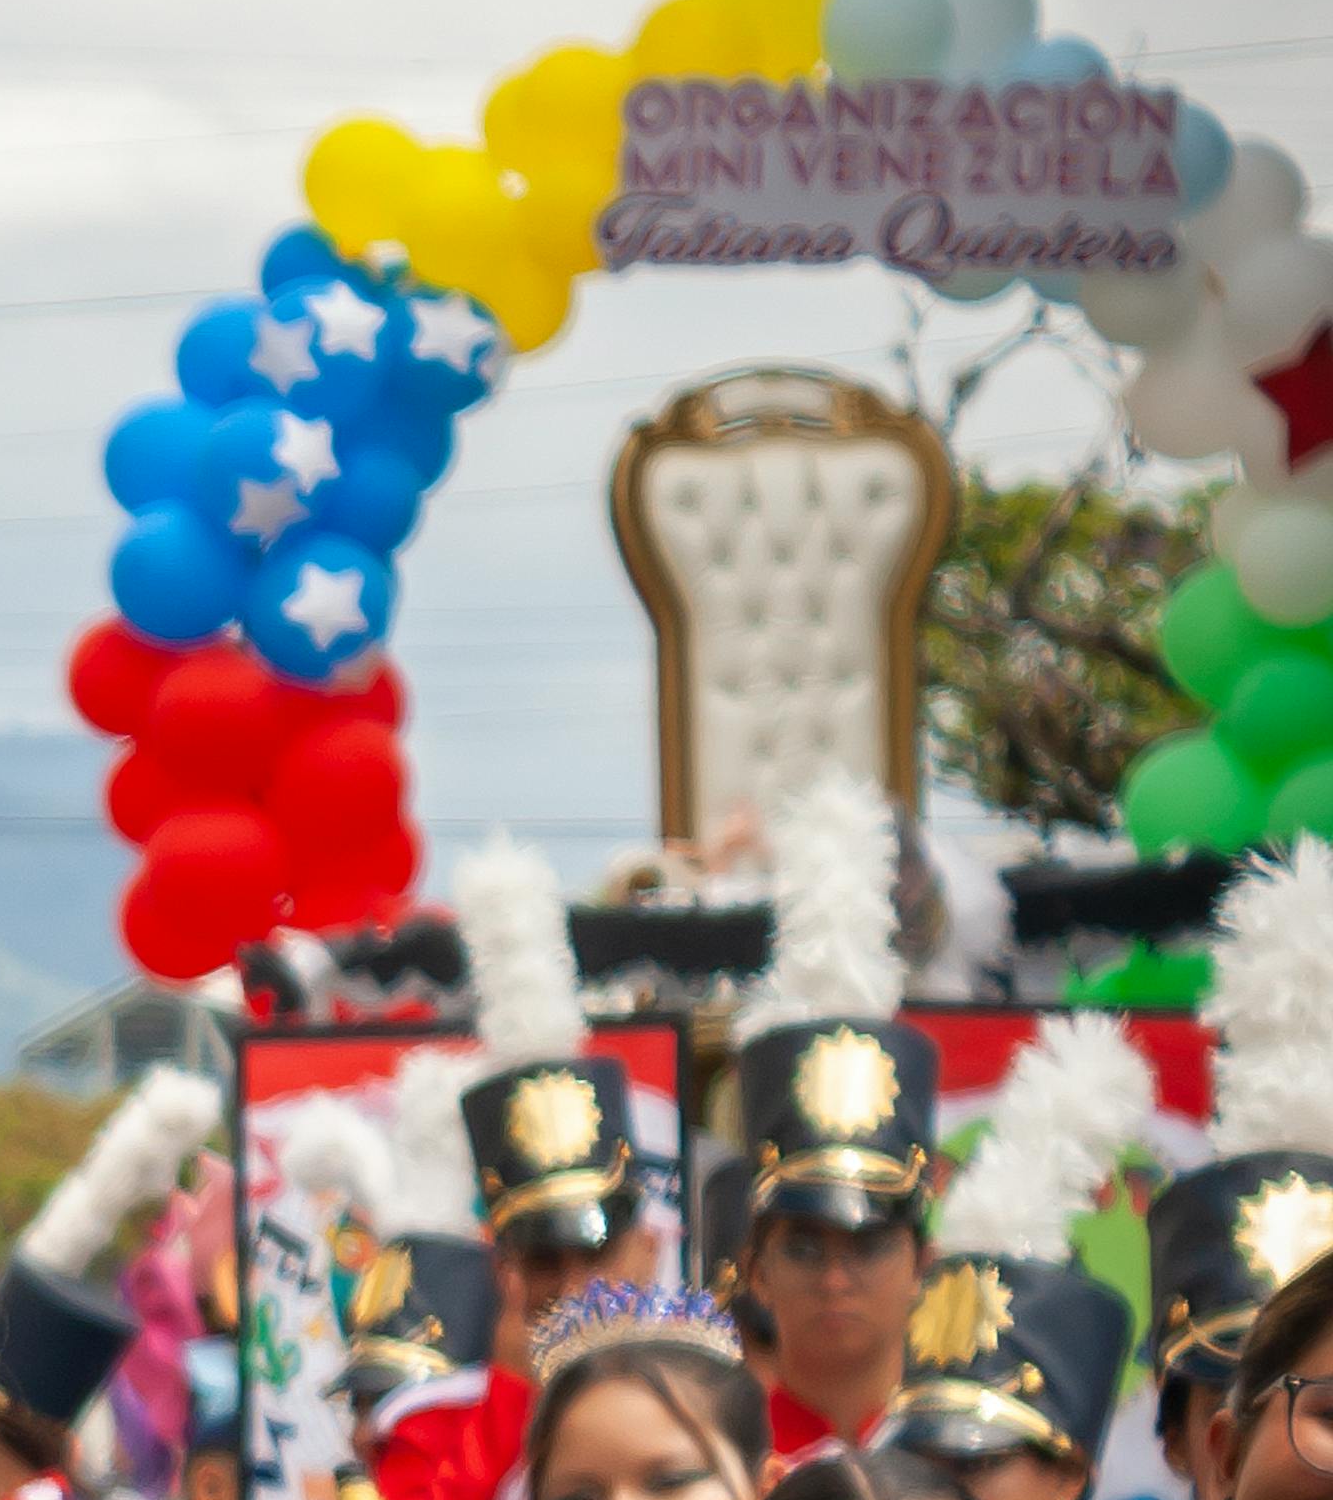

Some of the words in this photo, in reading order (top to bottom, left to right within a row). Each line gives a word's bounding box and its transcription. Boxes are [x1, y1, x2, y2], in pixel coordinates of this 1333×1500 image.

[626, 141, 765, 190] MINI
[789, 139, 1179, 195] VENEZUELA
[598, 192, 853, 270] Tatiana
